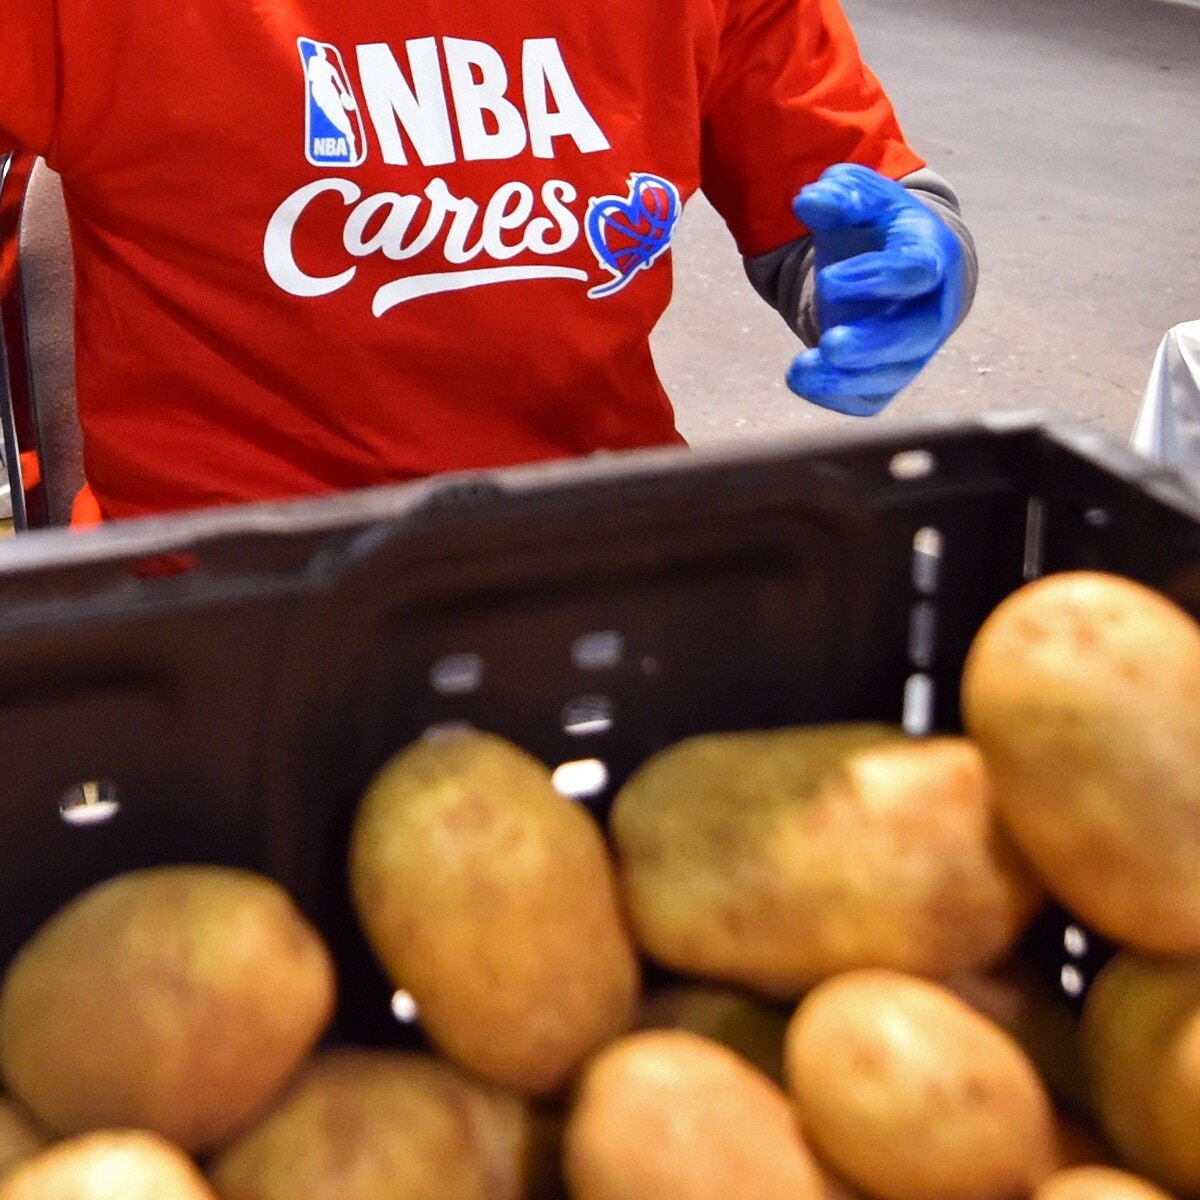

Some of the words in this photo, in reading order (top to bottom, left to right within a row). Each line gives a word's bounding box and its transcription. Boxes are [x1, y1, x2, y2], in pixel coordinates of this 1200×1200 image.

[313, 137, 348, 157] NBA
[355, 36, 611, 167] NBA
[263, 177, 580, 298] Cares
